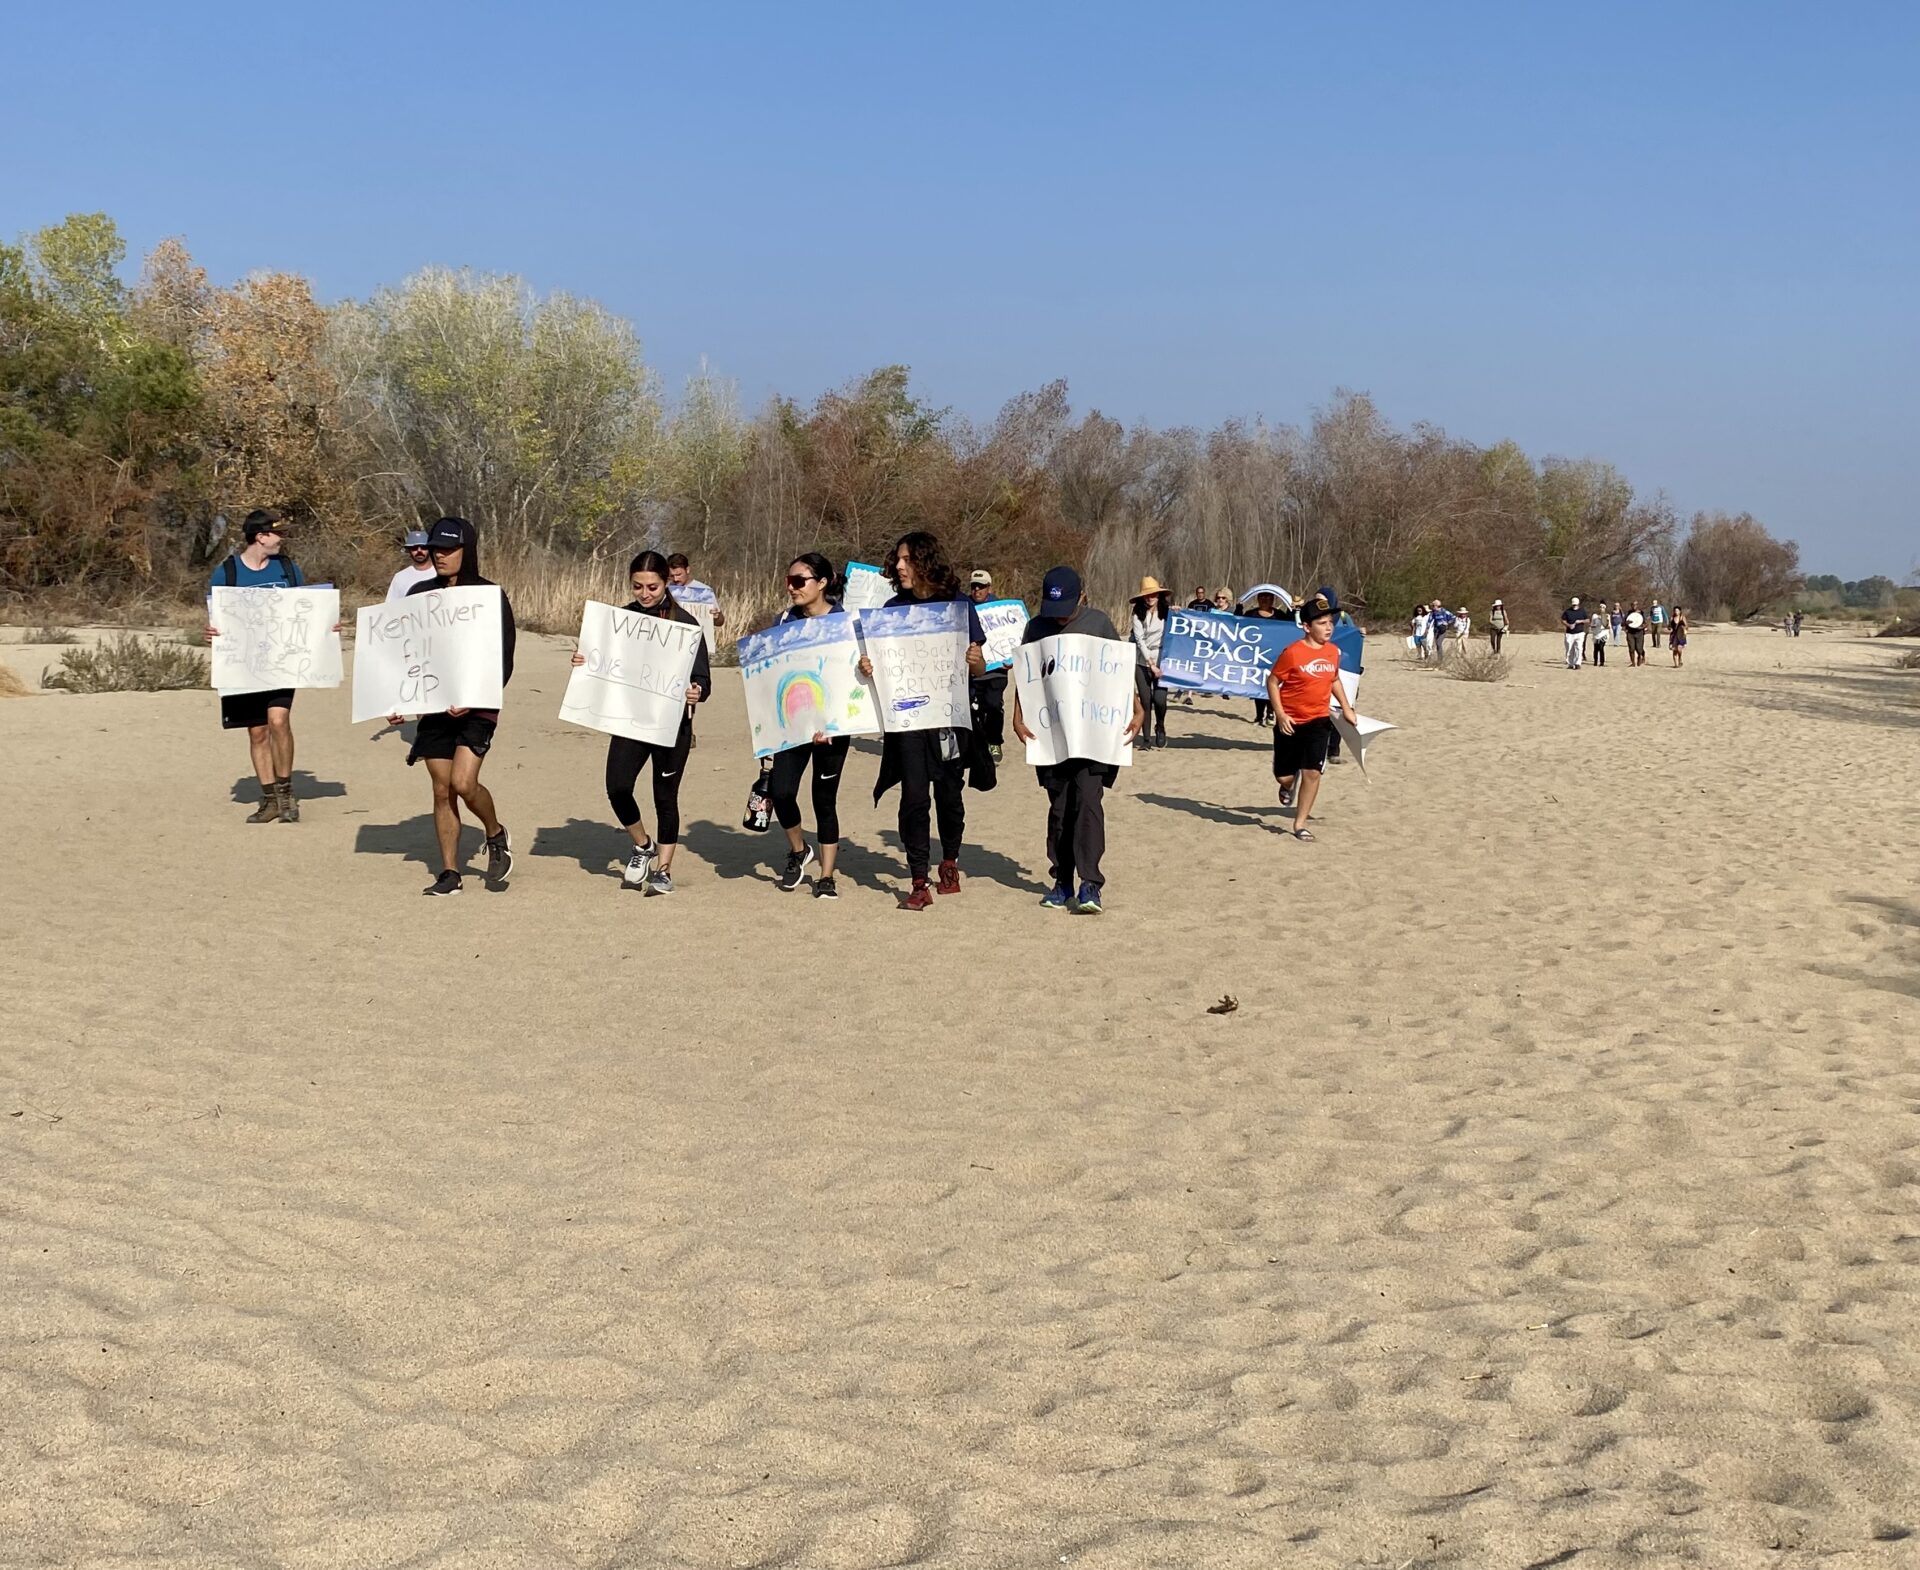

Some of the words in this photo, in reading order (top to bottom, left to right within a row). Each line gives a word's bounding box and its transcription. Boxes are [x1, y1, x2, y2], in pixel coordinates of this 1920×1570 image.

[424, 592, 484, 629] River
[265, 619, 309, 646] RUN
[612, 610, 704, 655] WANTE
[1169, 616, 1263, 644] BRING
[988, 637, 1022, 661] KER
[1099, 642, 1123, 675] for
[1193, 639, 1274, 666] BACK
[587, 648, 625, 679] ONE
[639, 664, 684, 697] RIVE
[1165, 657, 1199, 675] THE
[1299, 663, 1336, 673] VIRGINIA
